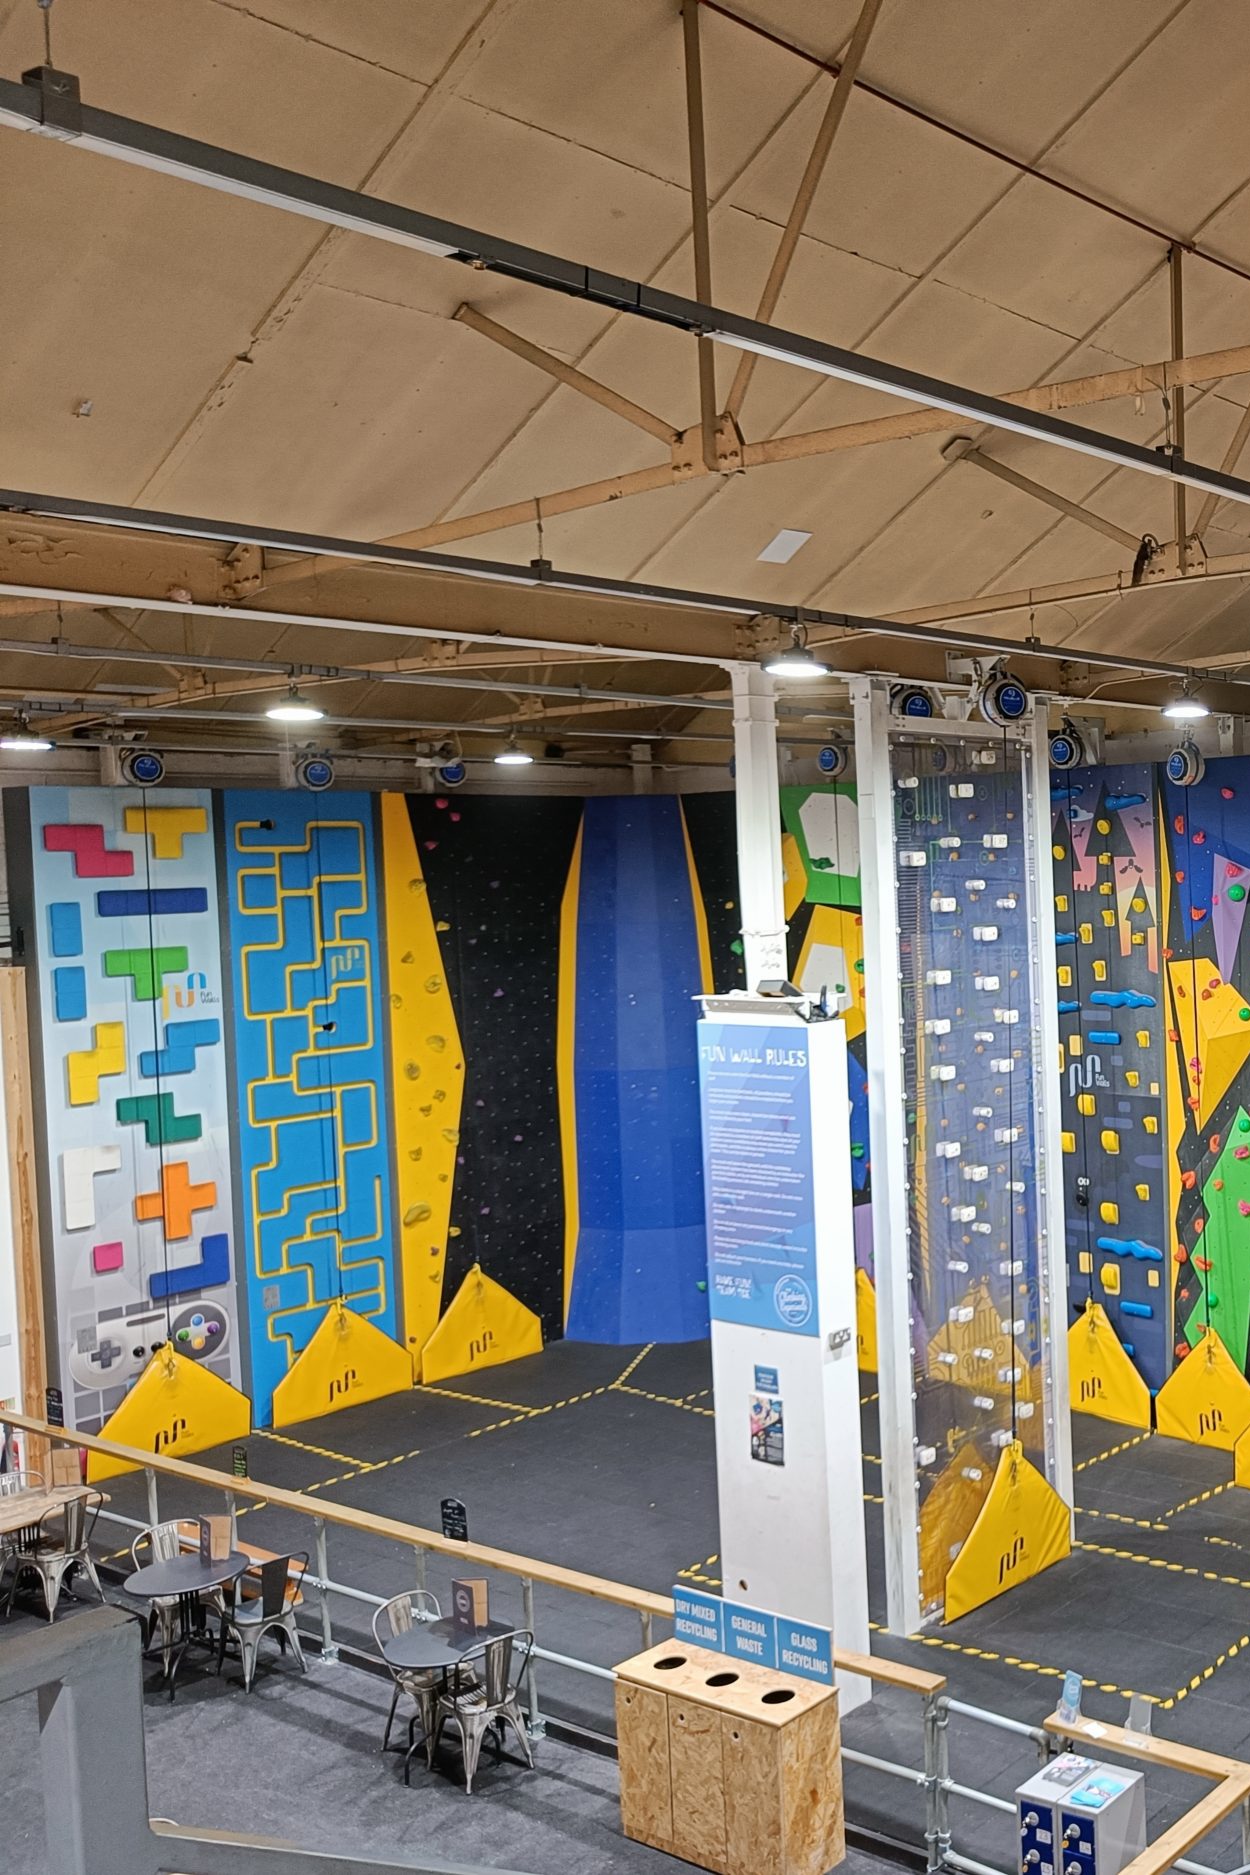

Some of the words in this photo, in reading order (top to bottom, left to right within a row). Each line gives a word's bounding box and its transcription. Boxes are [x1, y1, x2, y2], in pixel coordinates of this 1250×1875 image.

[701, 1045, 726, 1062] FUN
[729, 1047, 763, 1064] WALL
[766, 1048, 807, 1068] RULES
[676, 1599, 691, 1614] DRY
[691, 1604, 716, 1622] MIXED
[676, 1618, 718, 1642] RECYCLING
[731, 1615, 767, 1638] GENERAL
[736, 1636, 764, 1656] WASTE
[790, 1632, 817, 1652] GLASS
[782, 1650, 828, 1675] RECYCLING
